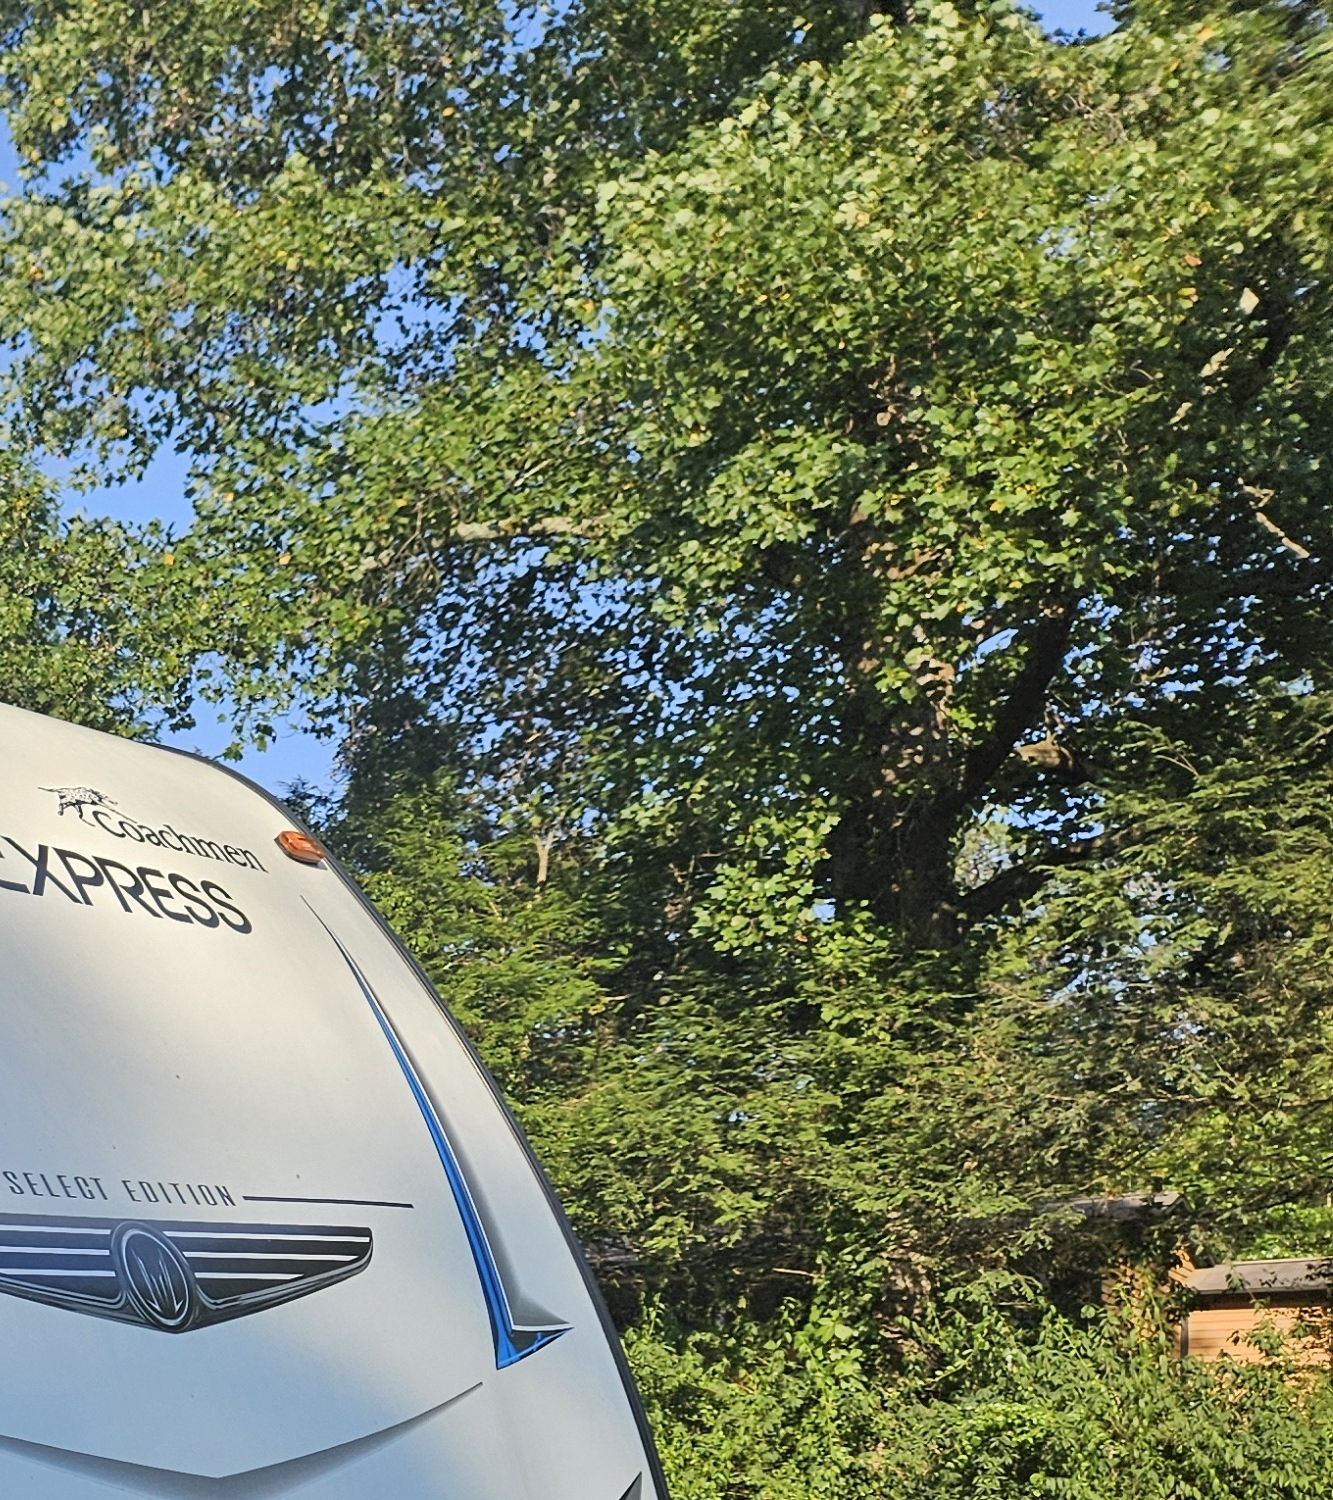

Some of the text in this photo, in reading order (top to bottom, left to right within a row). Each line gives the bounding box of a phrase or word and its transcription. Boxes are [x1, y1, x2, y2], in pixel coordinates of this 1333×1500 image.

[92, 810, 269, 873] Coachmen
[2, 1170, 236, 1207] SELECT EDITION
